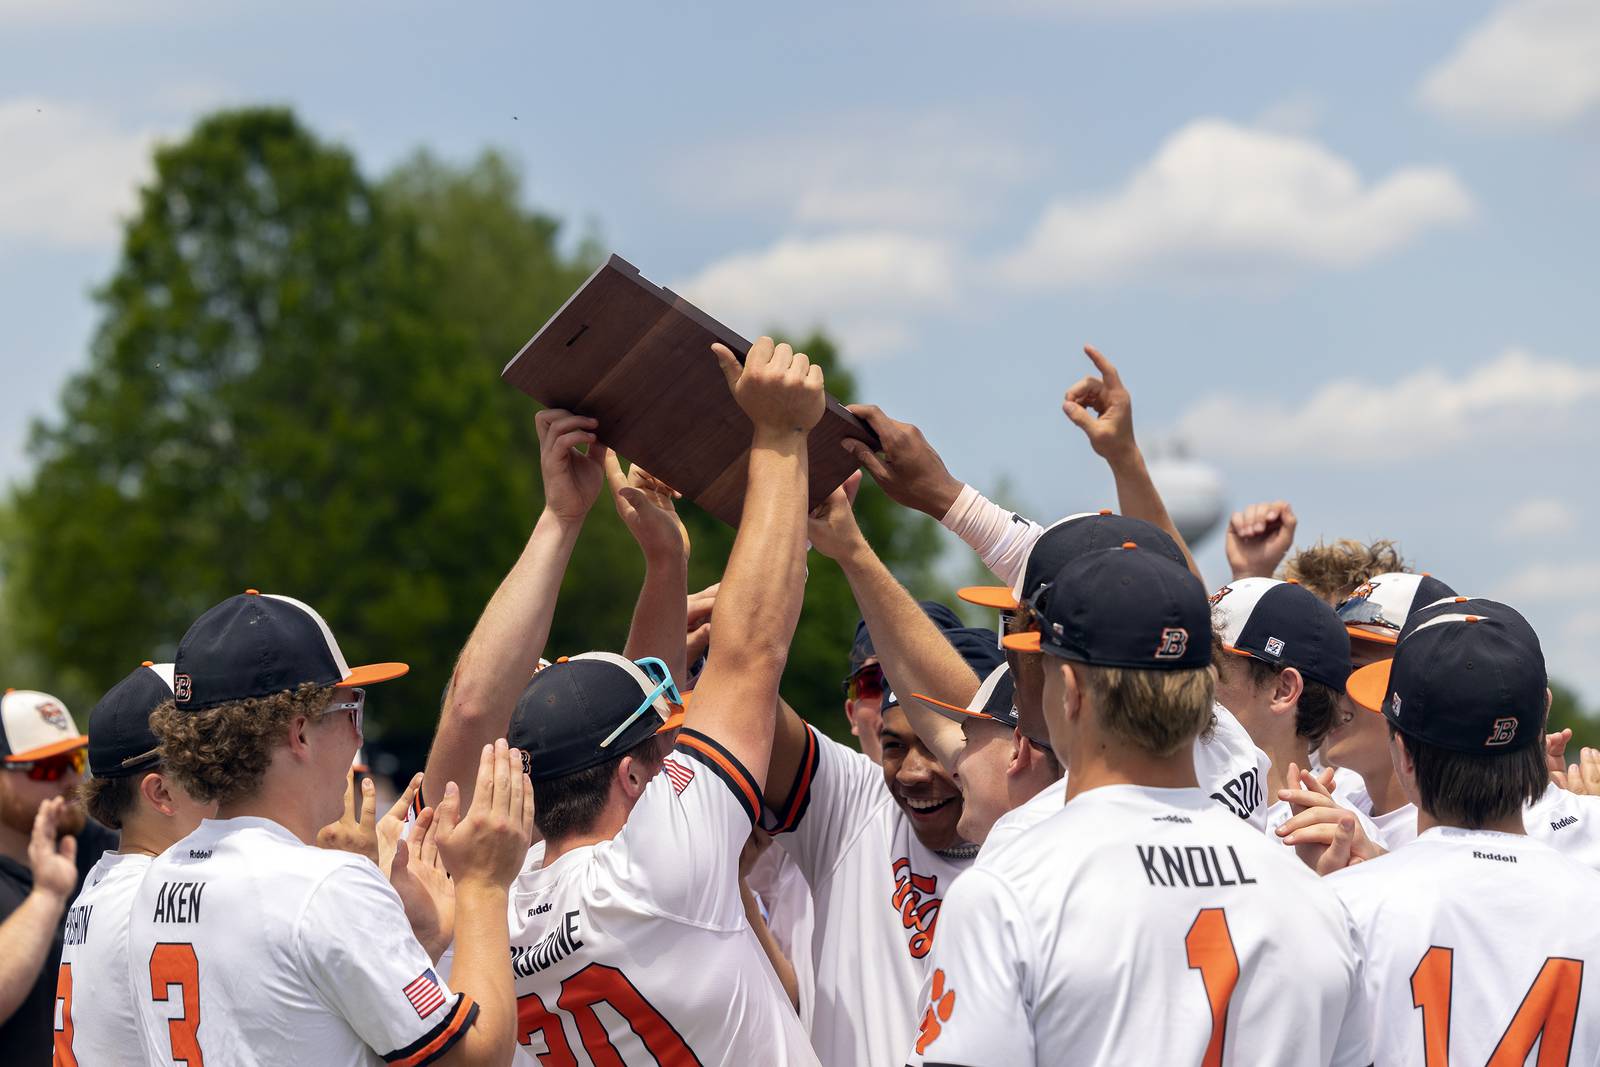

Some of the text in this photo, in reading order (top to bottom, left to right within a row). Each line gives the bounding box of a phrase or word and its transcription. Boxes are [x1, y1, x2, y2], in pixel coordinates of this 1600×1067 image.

[1153, 627, 1190, 660] B
[1484, 716, 1520, 747] B
[1135, 844, 1258, 888] KNOLL
[1472, 850, 1518, 864] Riddell
[153, 881, 206, 924] AKEN
[148, 941, 205, 1067] 3
[1184, 907, 1241, 1067] 1
[1409, 944, 1585, 1067] 14
